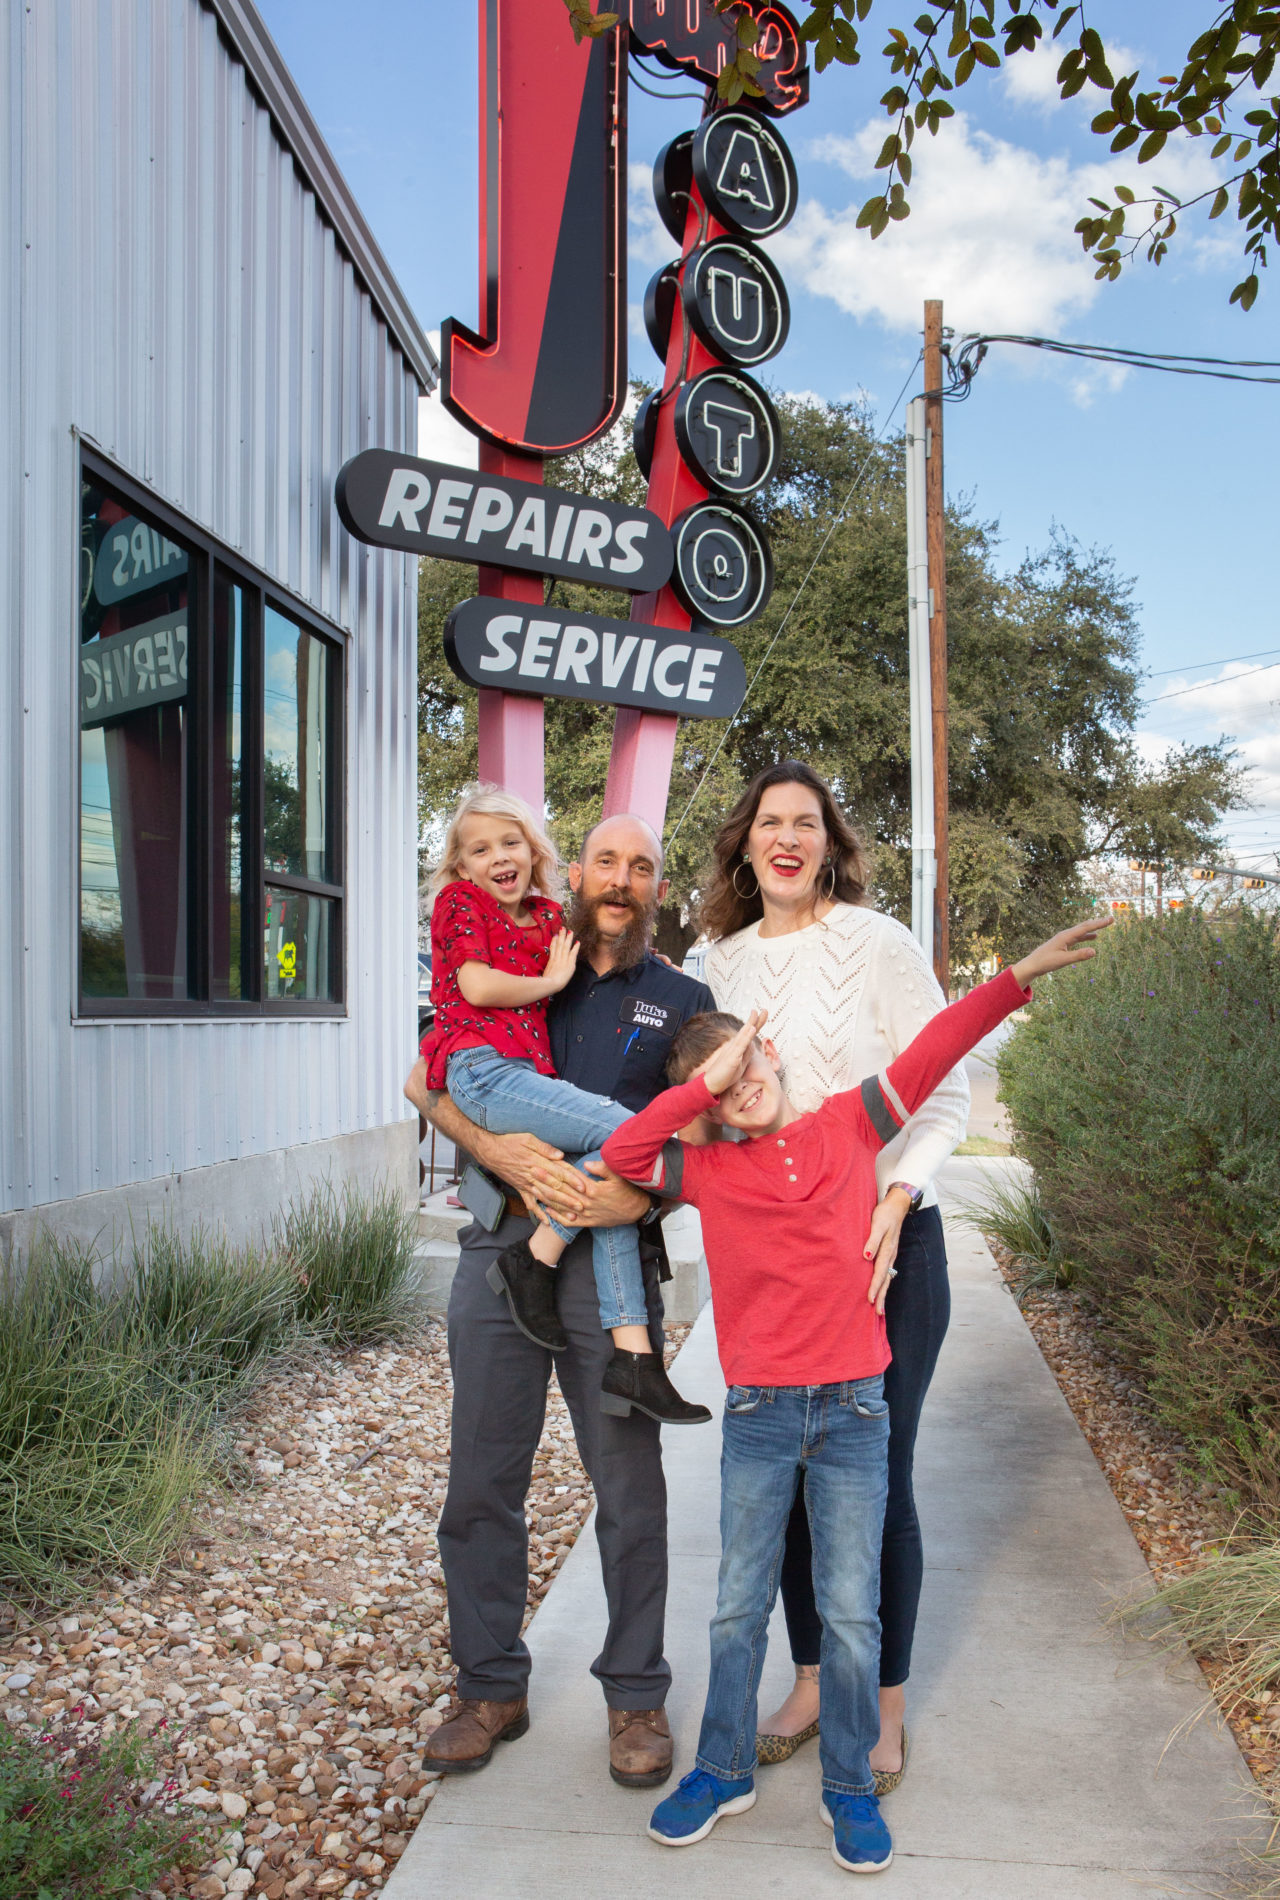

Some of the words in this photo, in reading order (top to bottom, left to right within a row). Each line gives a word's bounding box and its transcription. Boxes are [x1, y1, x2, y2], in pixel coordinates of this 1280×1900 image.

[692, 129, 774, 602] AUTO
[378, 468, 649, 574] REPAIRS
[479, 614, 723, 702] SERVICE
[632, 1013, 664, 1028] AUTO
[634, 1000, 668, 1018] Juke
